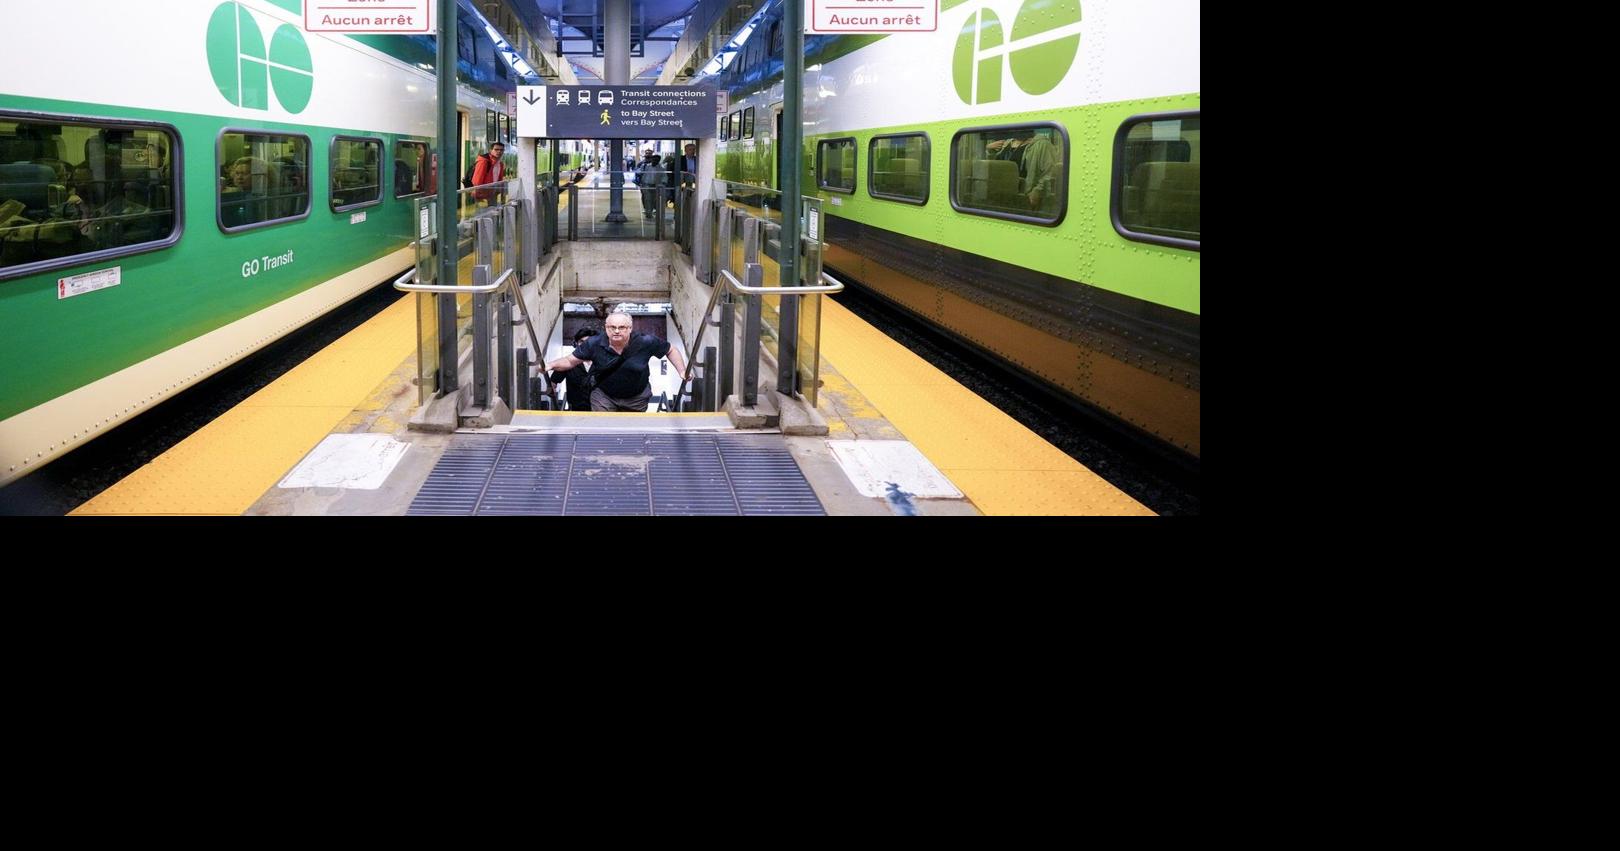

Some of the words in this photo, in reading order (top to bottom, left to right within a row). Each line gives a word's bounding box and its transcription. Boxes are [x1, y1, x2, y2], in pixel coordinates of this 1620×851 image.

[321, 14, 370, 26] Aucun
[374, 14, 414, 26] arrêt
[829, 14, 878, 25] Aucun
[882, 14, 921, 25] arrêt
[620, 98, 698, 106] Correspondances
[632, 110, 648, 118] Bay
[640, 119, 656, 127] Bay
[242, 259, 260, 277] GO
[262, 249, 294, 271] Transit
